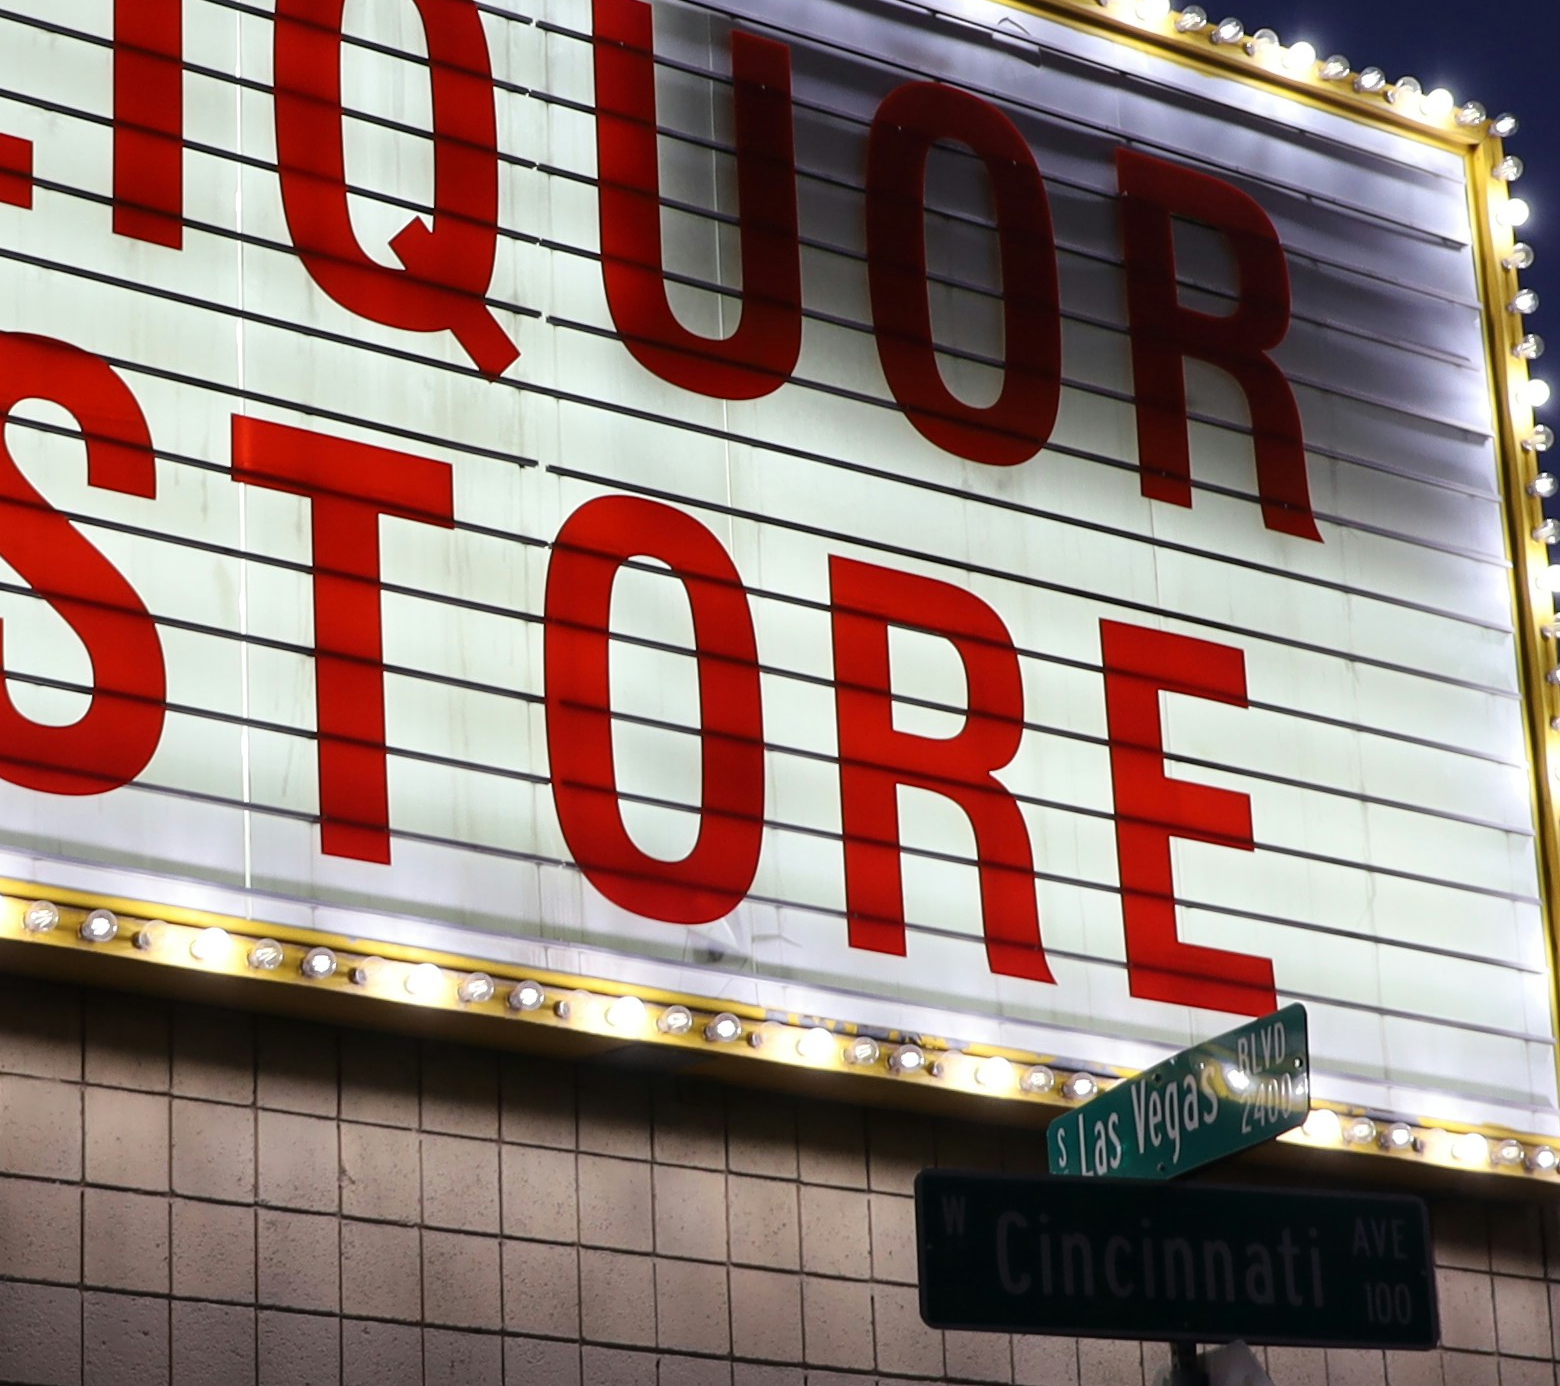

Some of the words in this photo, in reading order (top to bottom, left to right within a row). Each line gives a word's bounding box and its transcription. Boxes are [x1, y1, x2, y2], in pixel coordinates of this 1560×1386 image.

[1057, 1126, 1067, 1168] S
[1078, 1113, 1123, 1176] Las
[1130, 1064, 1219, 1163] Vegas
[1237, 1021, 1286, 1074] BLVD
[1240, 1072, 1294, 1135] 2400
[942, 1194, 967, 1236] W
[995, 1211, 1325, 1308] Cincinnati
[1352, 1216, 1406, 1261] AVE
[1365, 1282, 1412, 1325] 100
